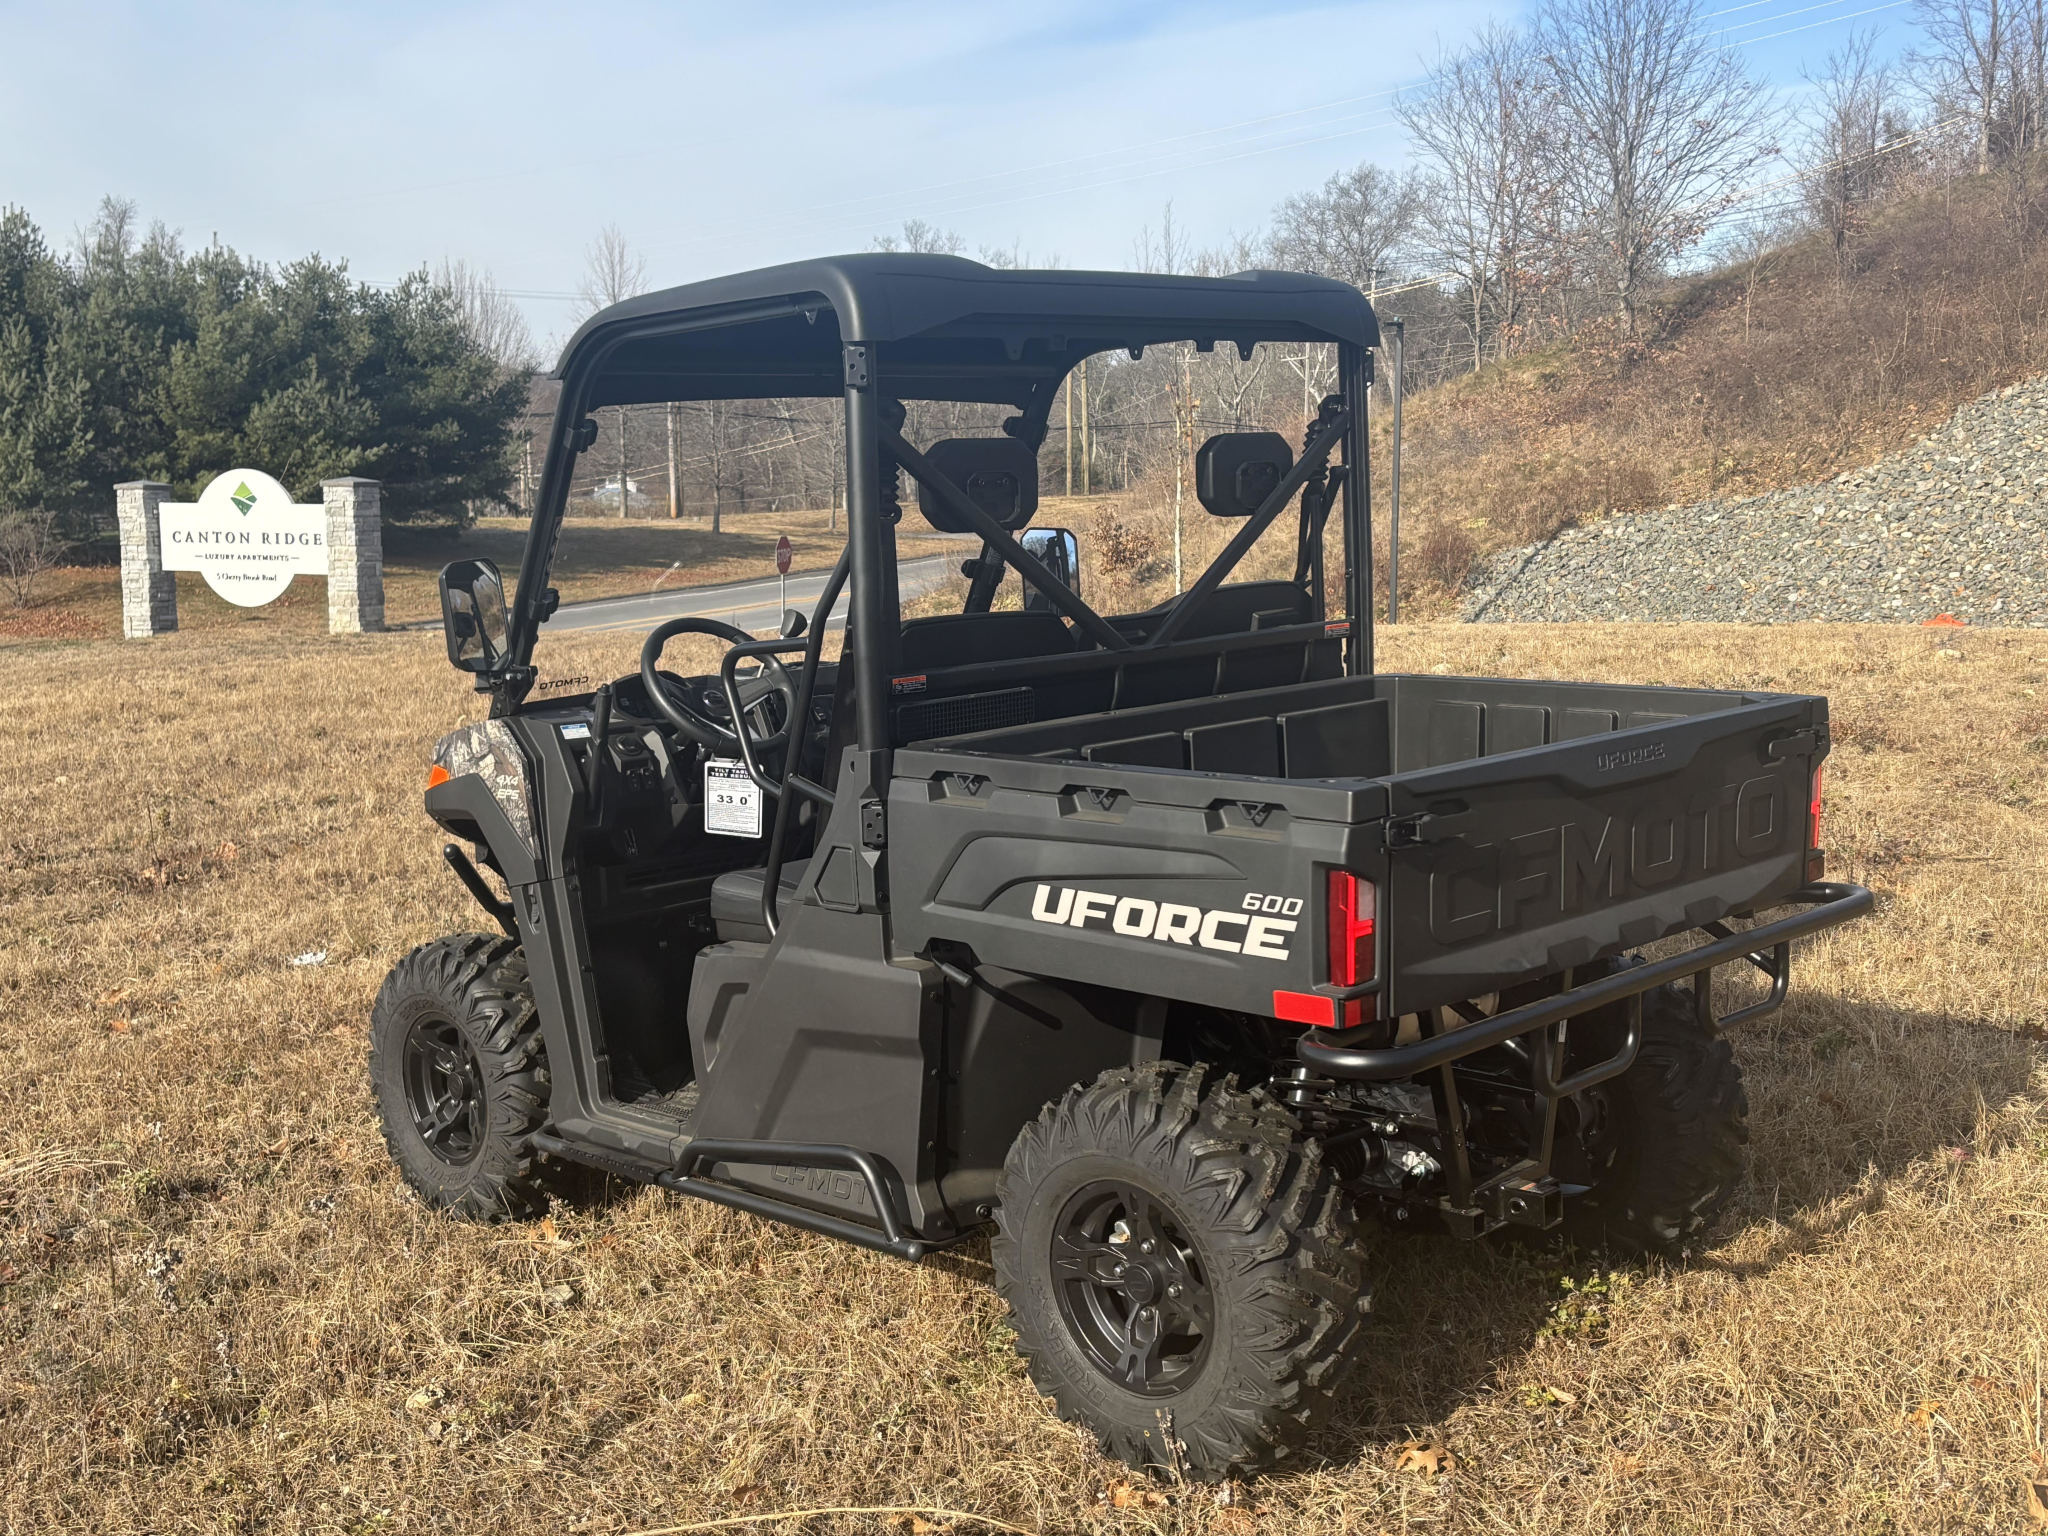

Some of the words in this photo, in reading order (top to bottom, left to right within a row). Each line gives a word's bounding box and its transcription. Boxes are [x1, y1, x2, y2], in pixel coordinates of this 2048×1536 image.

[172, 531, 250, 544] CANTON
[262, 532, 322, 546] RIDGE
[204, 553, 235, 561] LUXURY
[237, 554, 290, 562] APARTMENTS
[777, 548, 791, 563] STOP
[1597, 743, 1667, 772] UFORCE
[496, 774, 519, 786] 4X4
[496, 788, 520, 800] EPS
[1428, 774, 1788, 944] CFMOTO
[1031, 883, 1299, 961] UFORCE
[1241, 892, 1304, 917] 600
[770, 1164, 868, 1205] CFMOT
